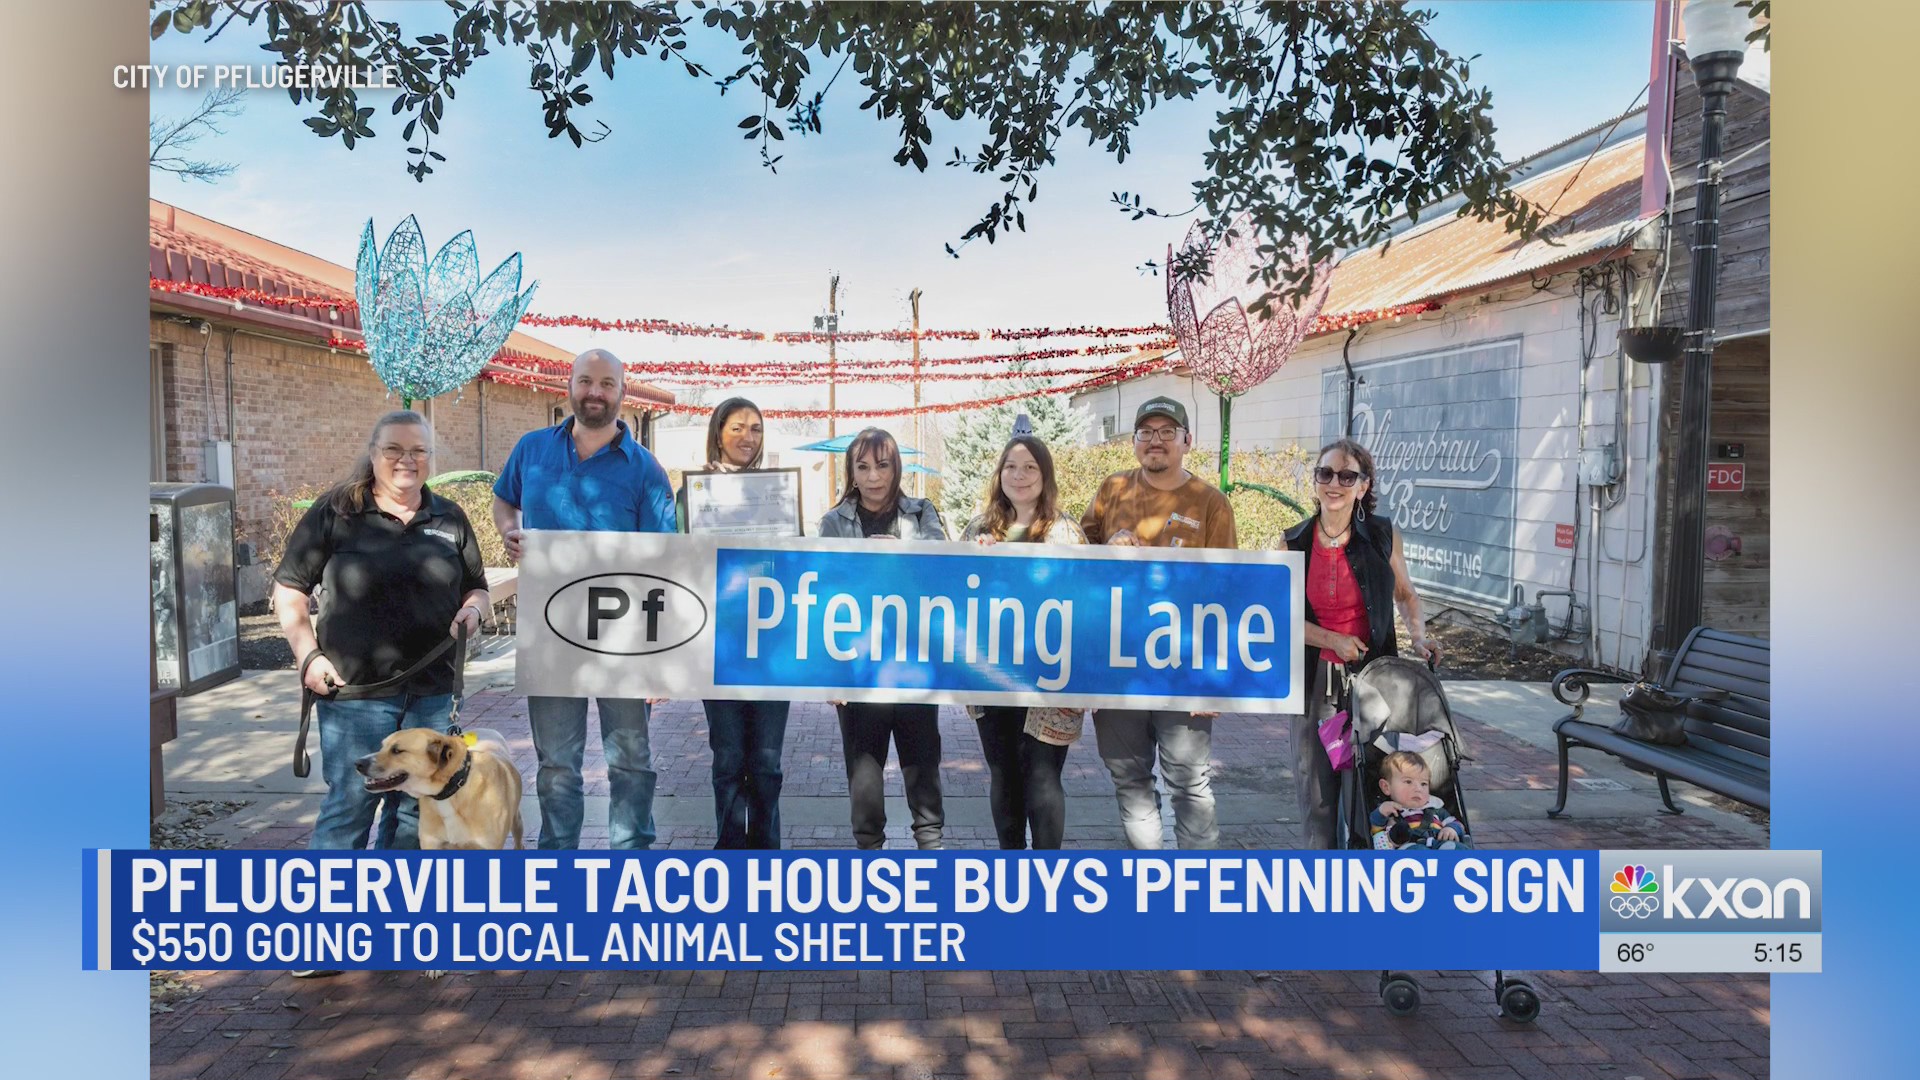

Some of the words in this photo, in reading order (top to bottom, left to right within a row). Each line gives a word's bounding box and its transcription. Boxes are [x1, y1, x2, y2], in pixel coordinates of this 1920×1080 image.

[1708, 469, 1742, 485] FDC
[1388, 481, 1453, 533] Beer
[1402, 542, 1482, 579] EFRESHING
[586, 586, 665, 643] Pf
[746, 571, 1074, 690] Pfenning
[1109, 586, 1276, 672] Lane
